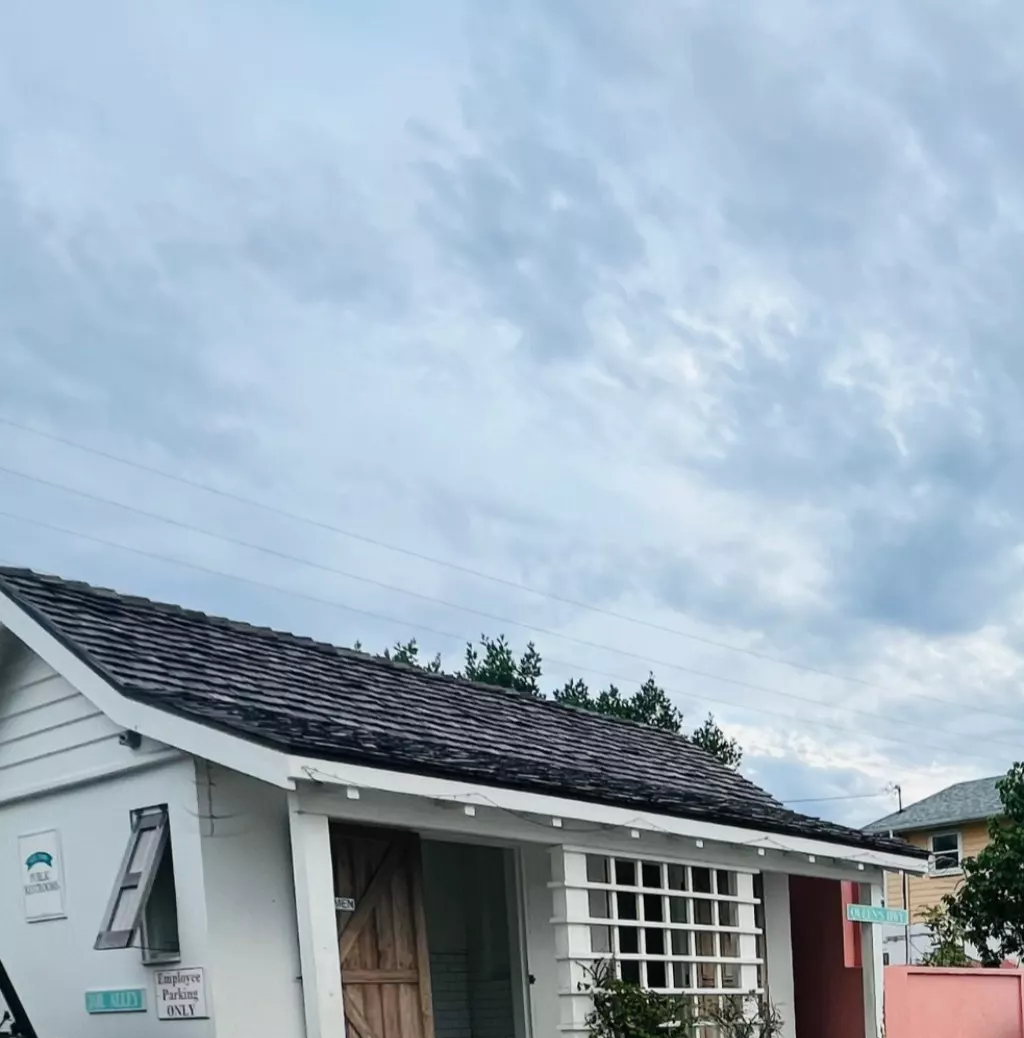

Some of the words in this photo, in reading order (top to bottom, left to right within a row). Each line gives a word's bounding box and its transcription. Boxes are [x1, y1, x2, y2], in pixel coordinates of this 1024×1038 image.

[157, 971, 200, 987] Employee
[162, 987, 199, 1003] Parking
[167, 1004, 195, 1016] ONLY
